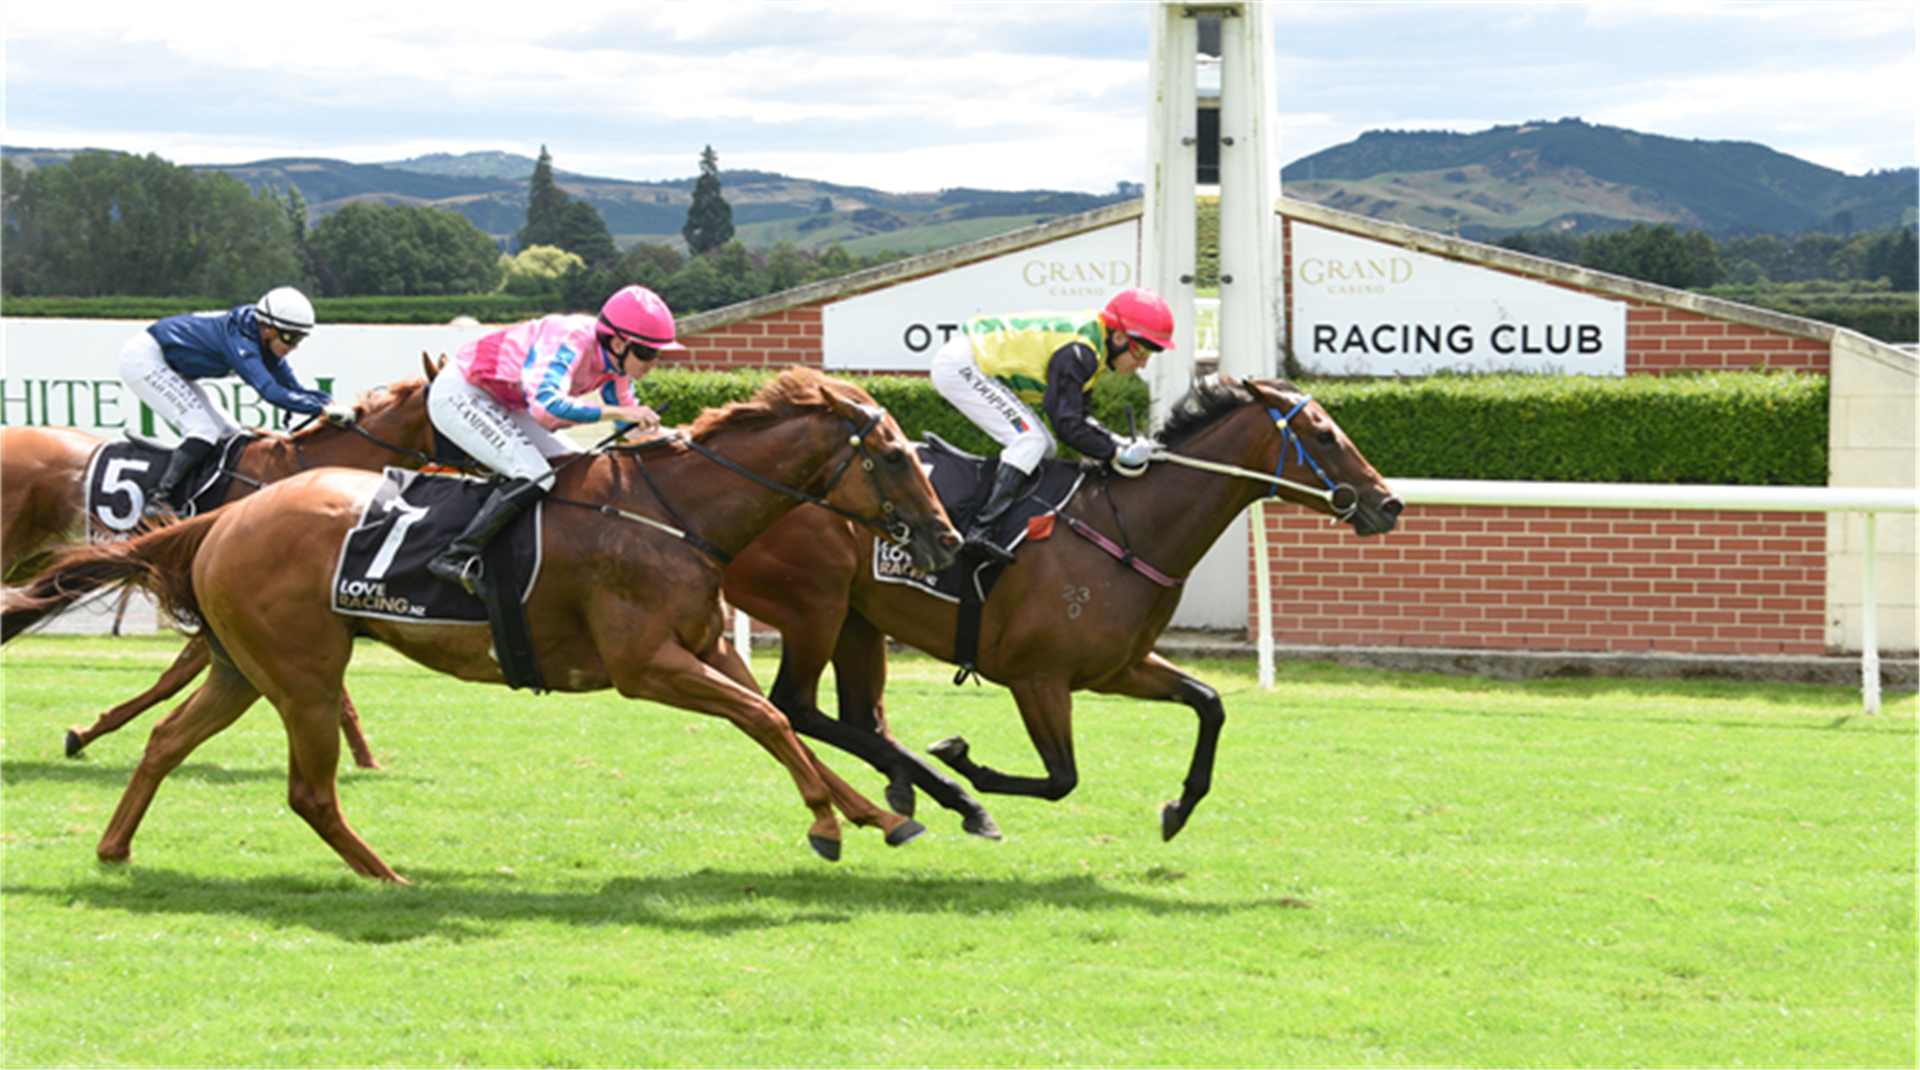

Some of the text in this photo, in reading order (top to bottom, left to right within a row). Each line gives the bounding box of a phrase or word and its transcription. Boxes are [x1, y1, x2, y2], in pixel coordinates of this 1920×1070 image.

[1023, 260, 1132, 287] GRAND
[1299, 257, 1413, 285] GRAND
[1050, 287, 1105, 297] CASINO
[1328, 285, 1385, 295] CASINO
[1313, 325, 1603, 354] RACING CLUB
[97, 458, 150, 531] 5
[365, 495, 430, 579] 7
[339, 579, 387, 597] LOVE
[1062, 584, 1091, 603] 23
